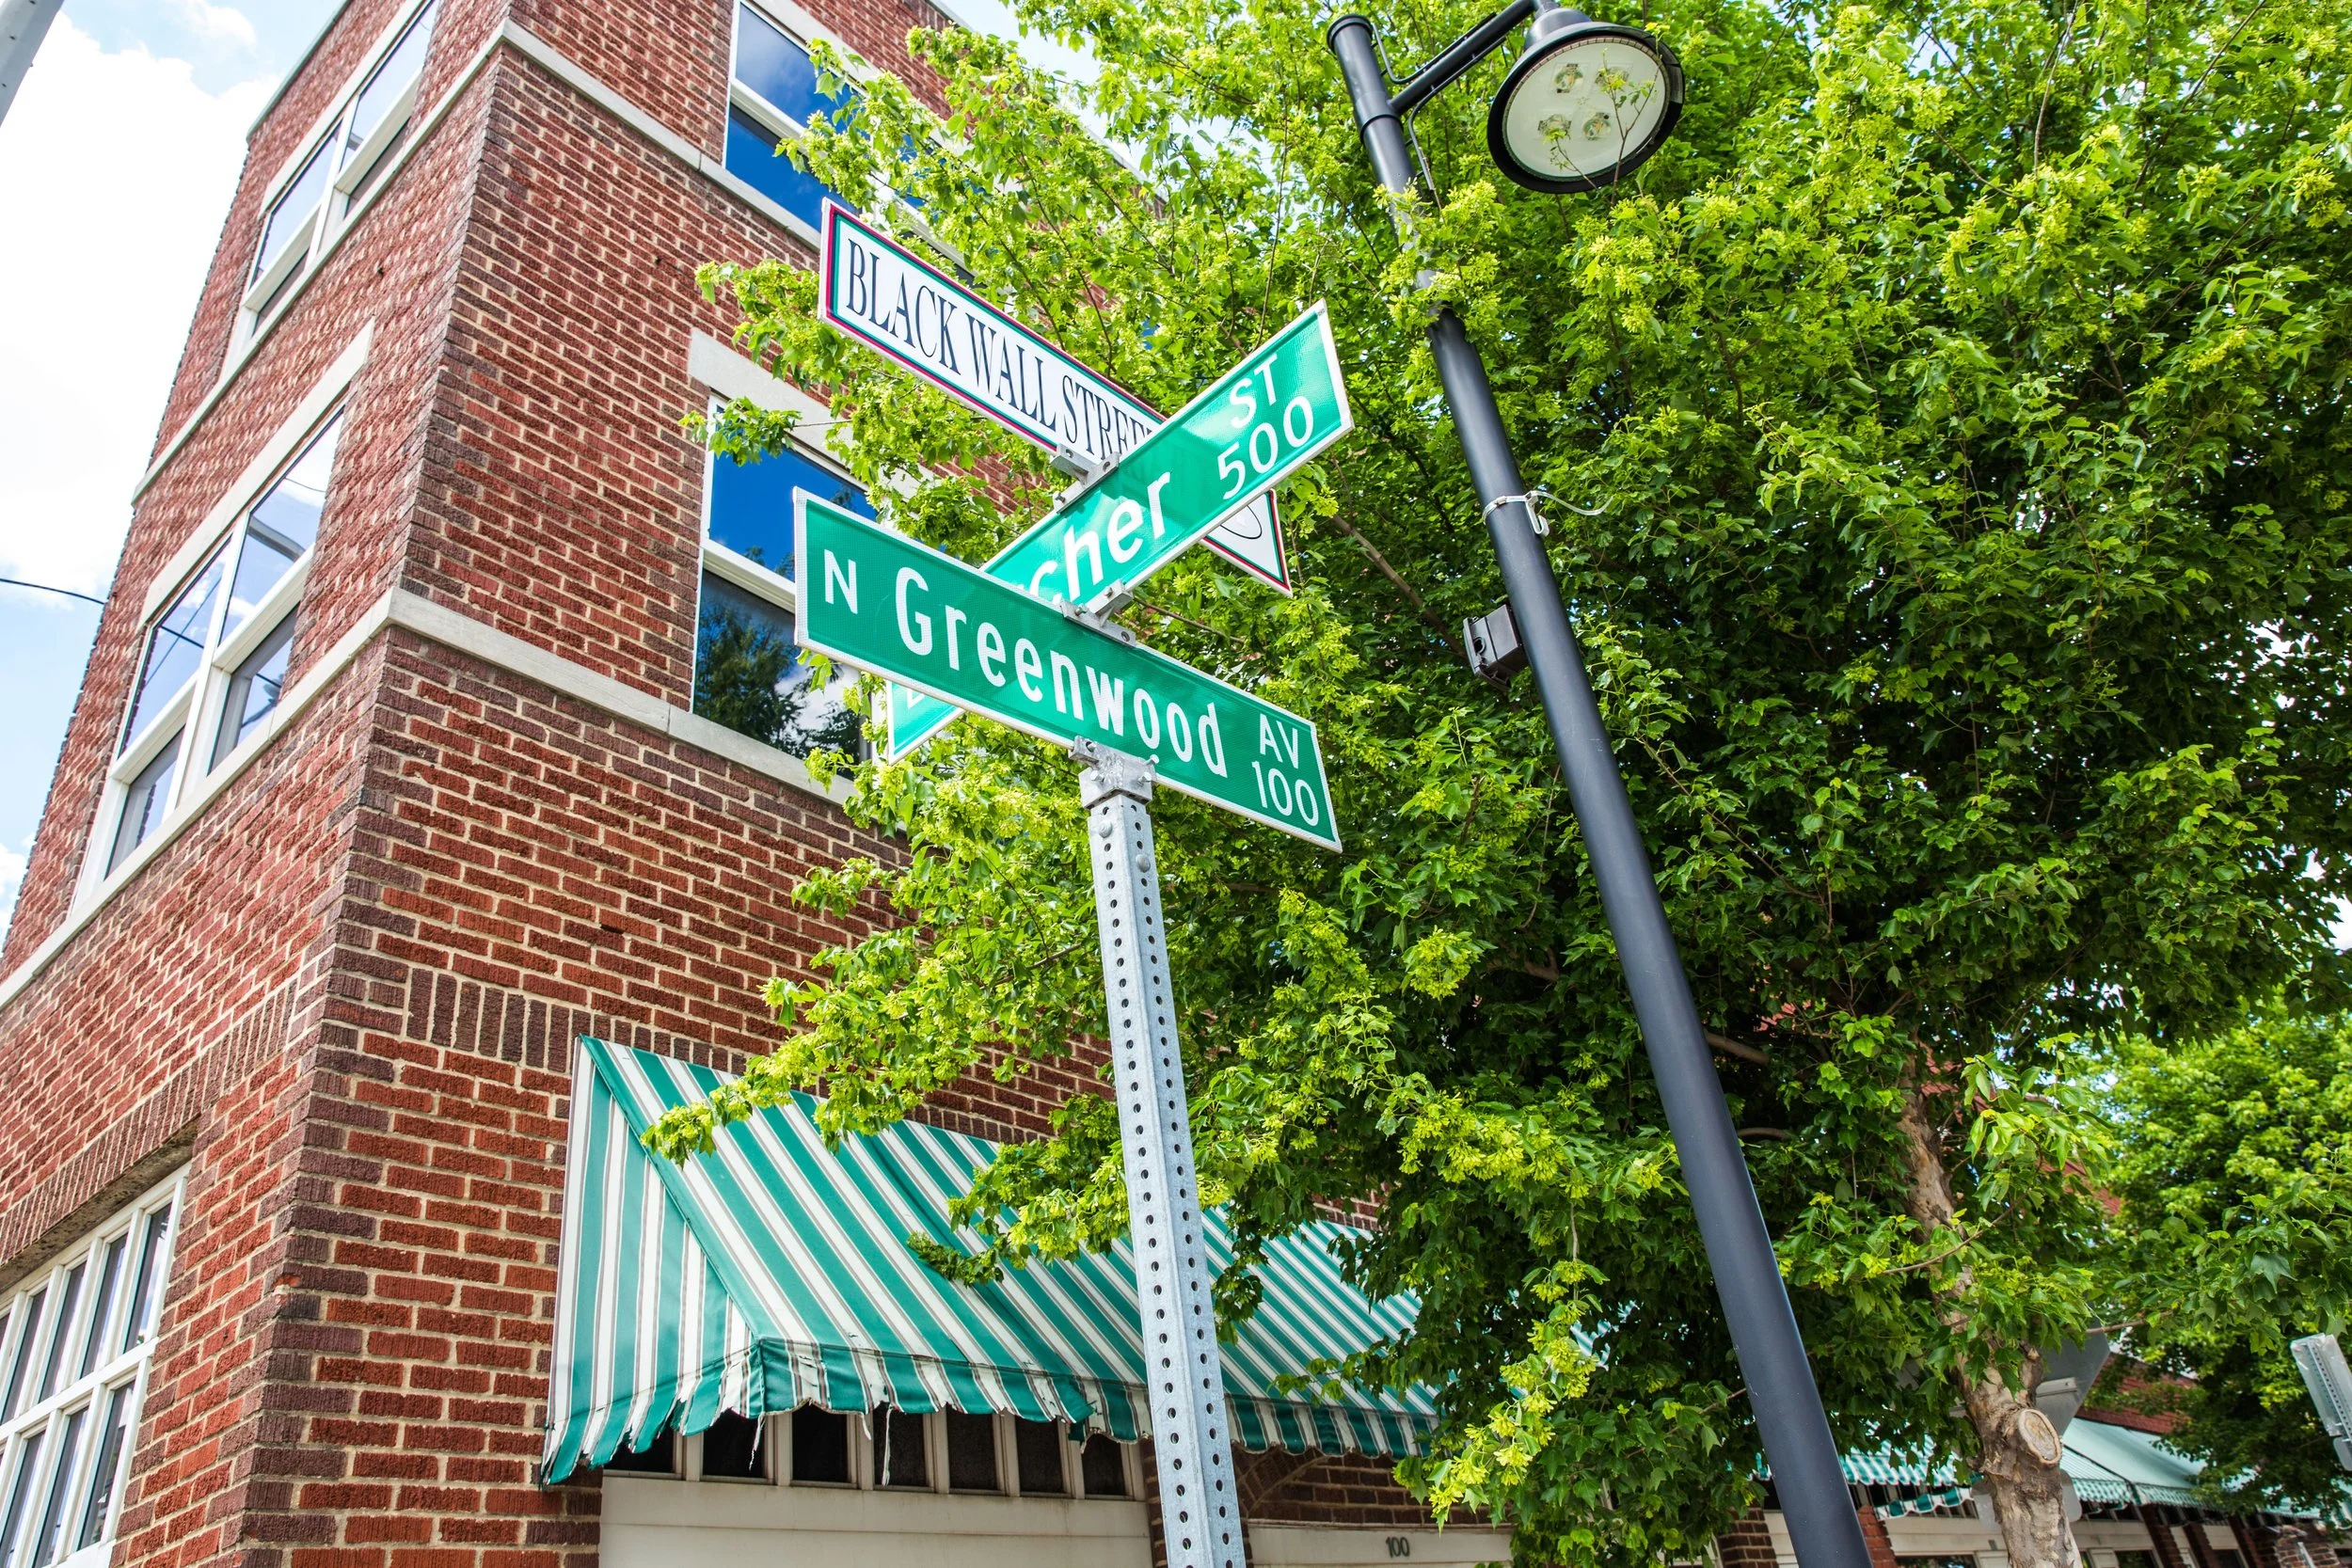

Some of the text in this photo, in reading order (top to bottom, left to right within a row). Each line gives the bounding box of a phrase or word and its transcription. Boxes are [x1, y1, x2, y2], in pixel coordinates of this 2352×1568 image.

[846, 238, 1152, 460] BLACK WALL STRE
[1229, 353, 1278, 429] ST
[1216, 396, 1314, 500] 500
[823, 549, 1298, 779] N Greenwood AV
[1251, 760, 1319, 827] 100
[1385, 1536, 1410, 1559] 100
